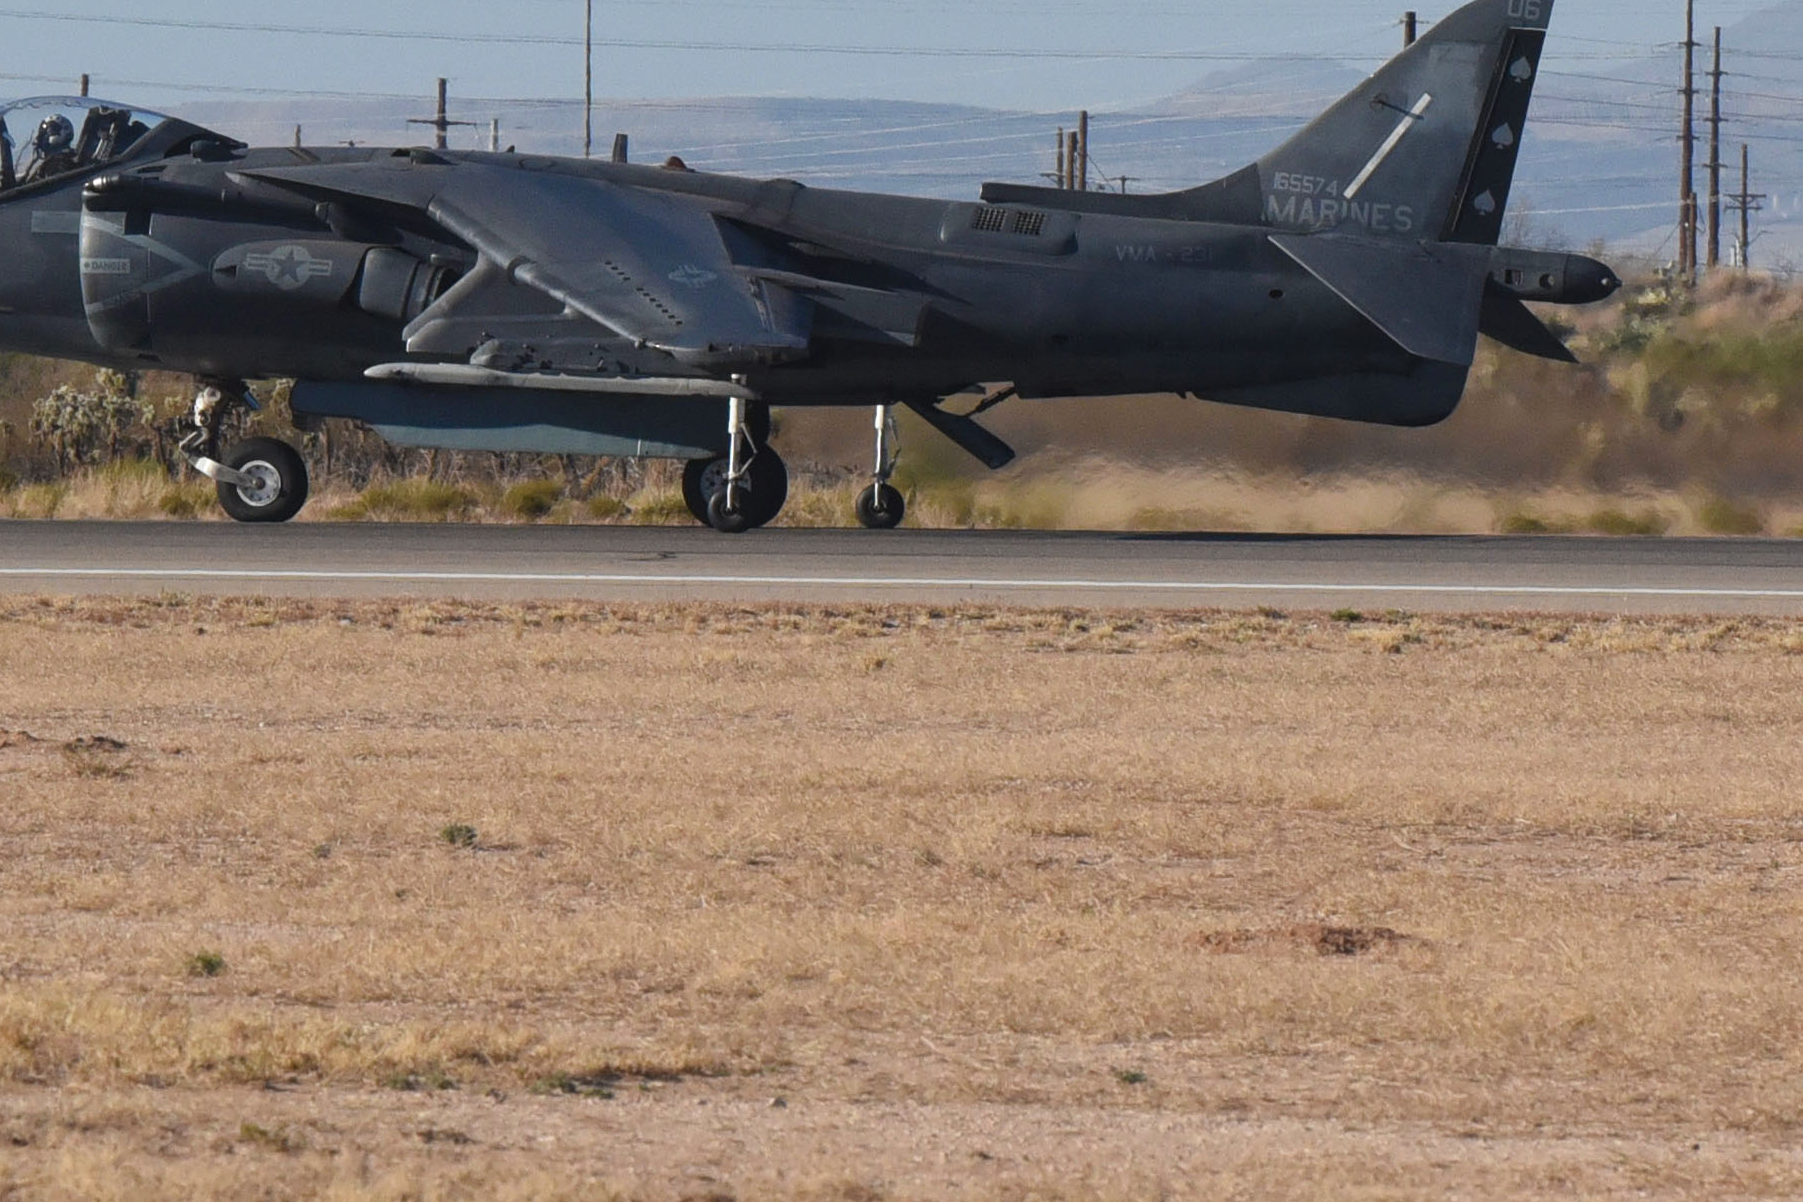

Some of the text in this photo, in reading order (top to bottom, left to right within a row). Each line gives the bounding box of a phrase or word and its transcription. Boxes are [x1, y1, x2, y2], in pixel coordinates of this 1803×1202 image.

[1273, 171, 1338, 197] 165574
[1265, 195, 1414, 231] MARINES
[1115, 244, 1157, 262] VMA
[91, 260, 128, 272] DANGER
